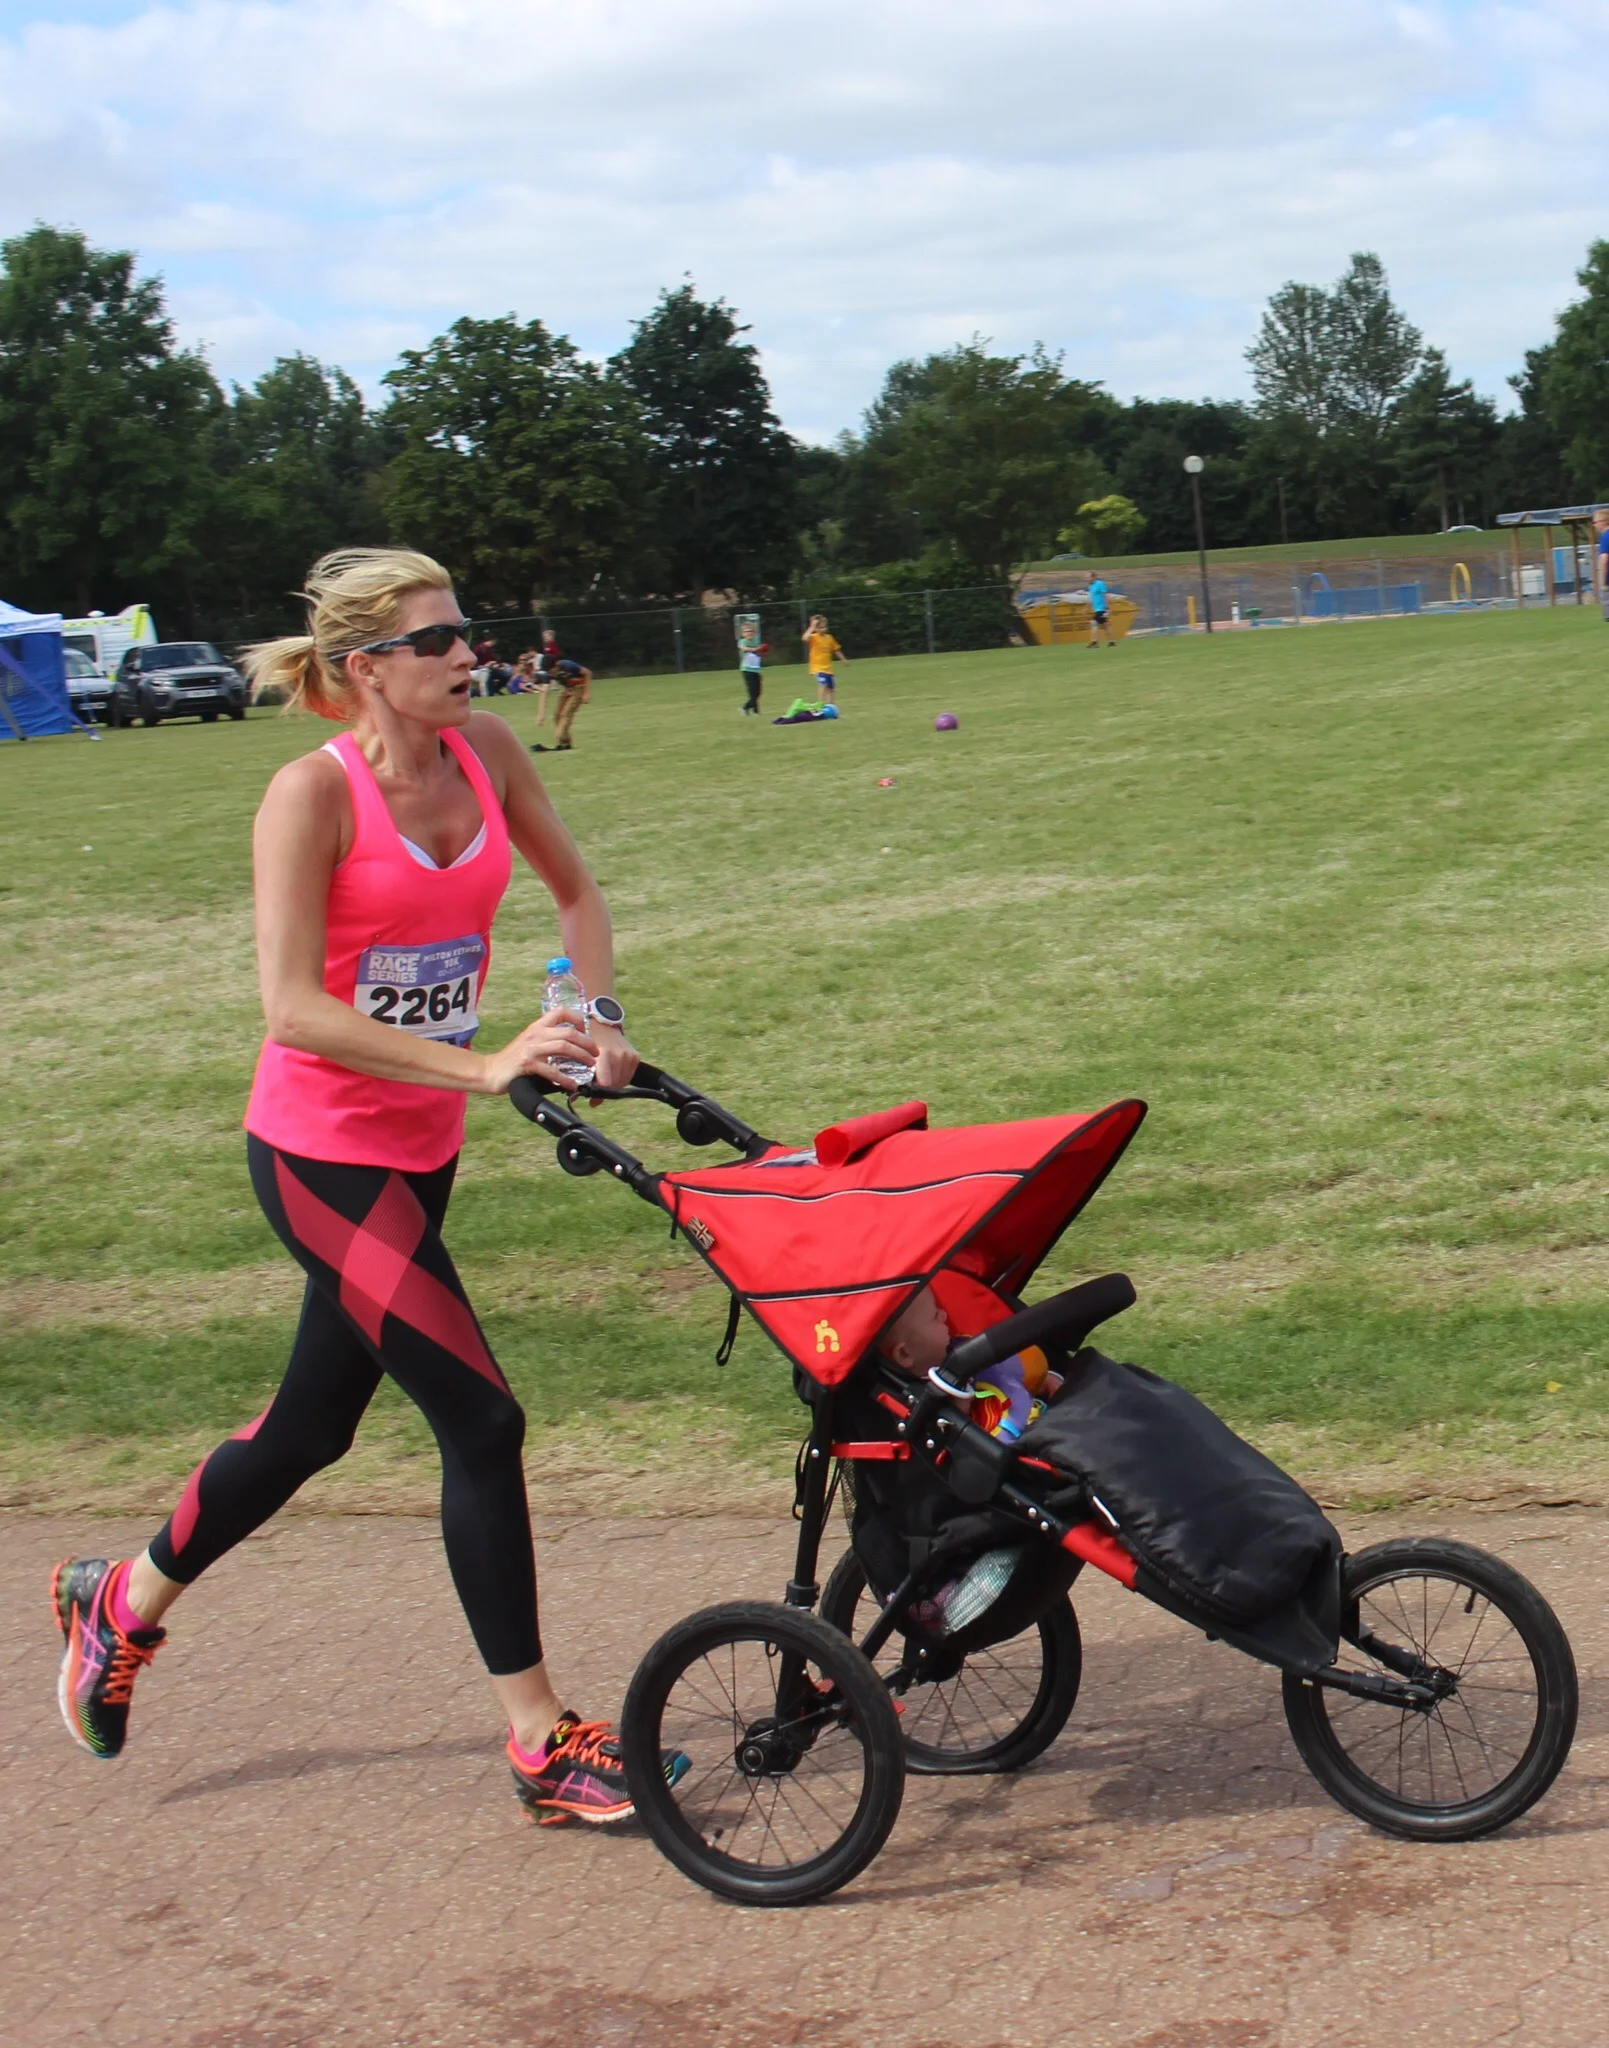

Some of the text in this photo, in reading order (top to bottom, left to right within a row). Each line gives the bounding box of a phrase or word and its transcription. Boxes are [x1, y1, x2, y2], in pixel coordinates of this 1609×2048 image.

[370, 955, 419, 972] RACE
[423, 951, 452, 963] MILTON
[368, 970, 418, 983] SERIES
[370, 977, 470, 1025] 2264
